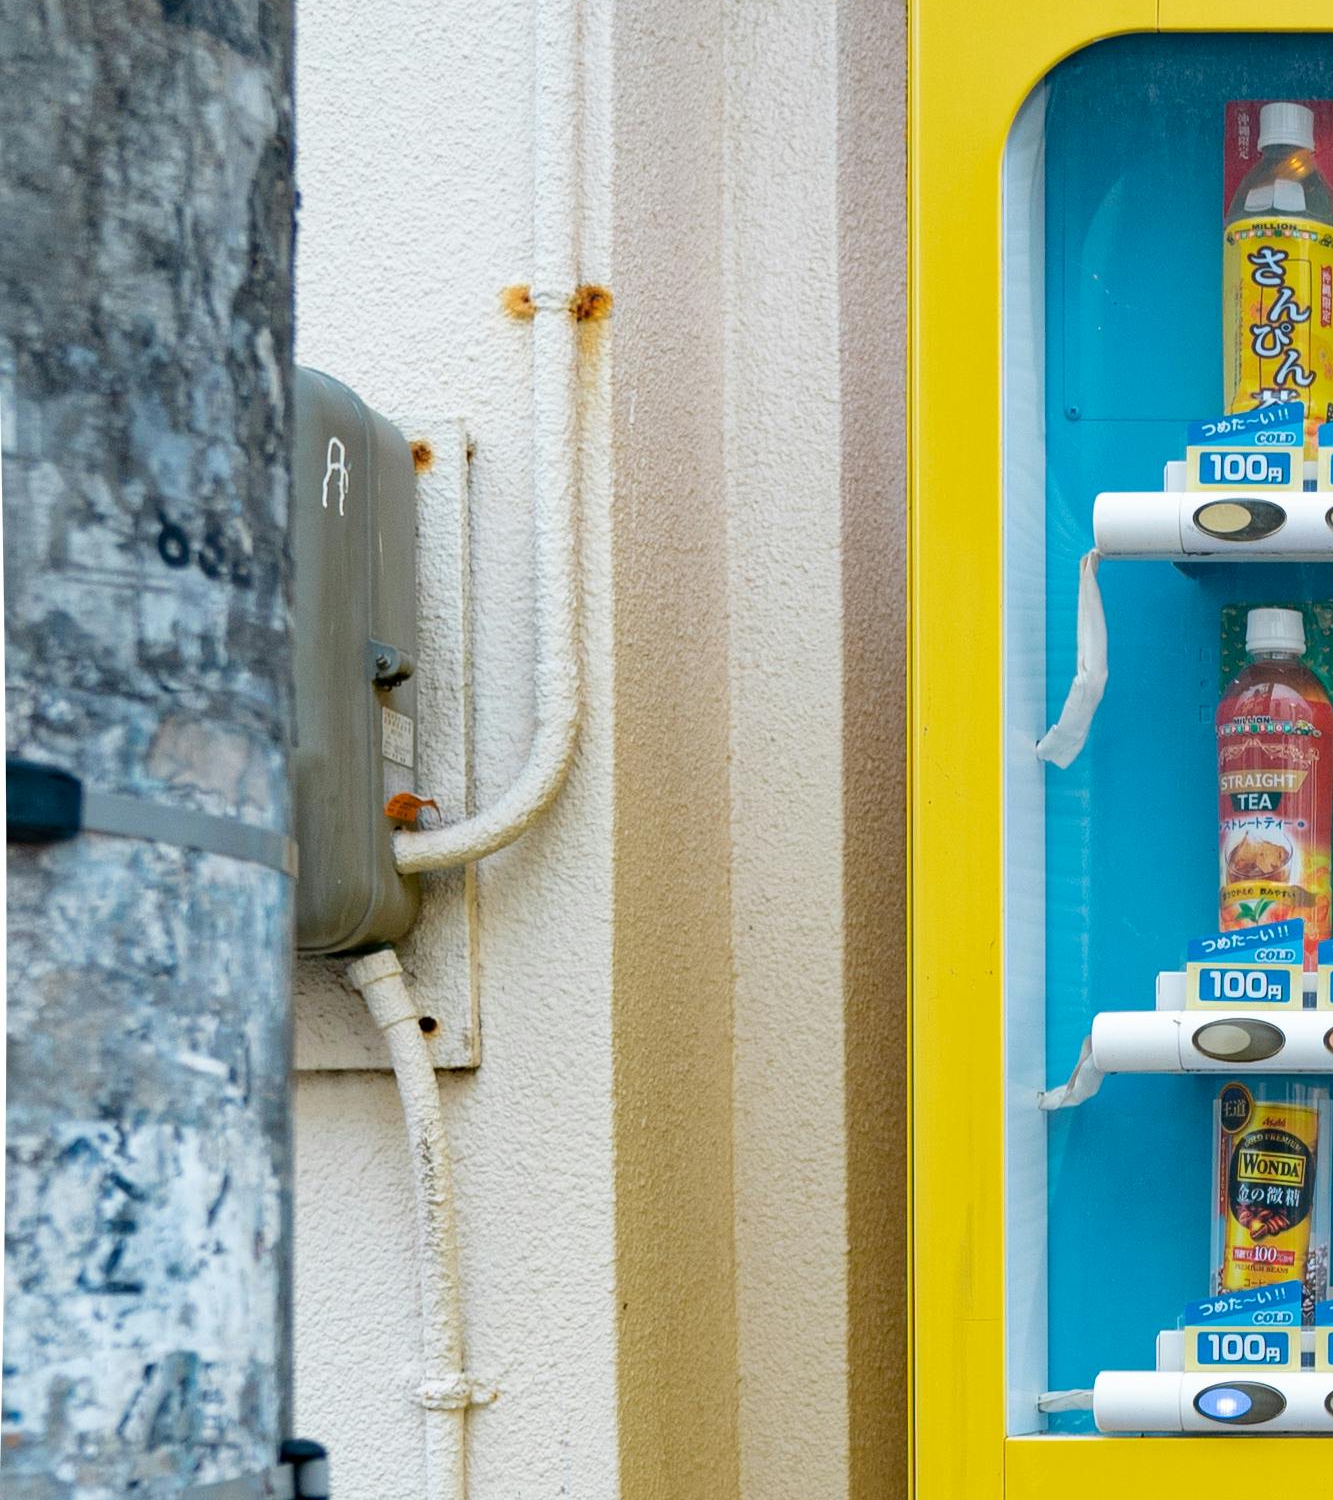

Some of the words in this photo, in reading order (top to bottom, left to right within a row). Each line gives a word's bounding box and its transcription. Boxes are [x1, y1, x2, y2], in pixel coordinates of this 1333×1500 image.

[1251, 222, 1297, 231] MILLION
[1255, 432, 1295, 445] COLD
[1209, 453, 1283, 482] 100円
[1233, 716, 1270, 724] MILLION
[1221, 773, 1297, 790] STRAIGHT
[1237, 795, 1272, 810] TEA
[1242, 1155, 1300, 1178] WONDA
[1237, 1185, 1299, 1207] 金の微糖
[1253, 1312, 1293, 1325] COLD
